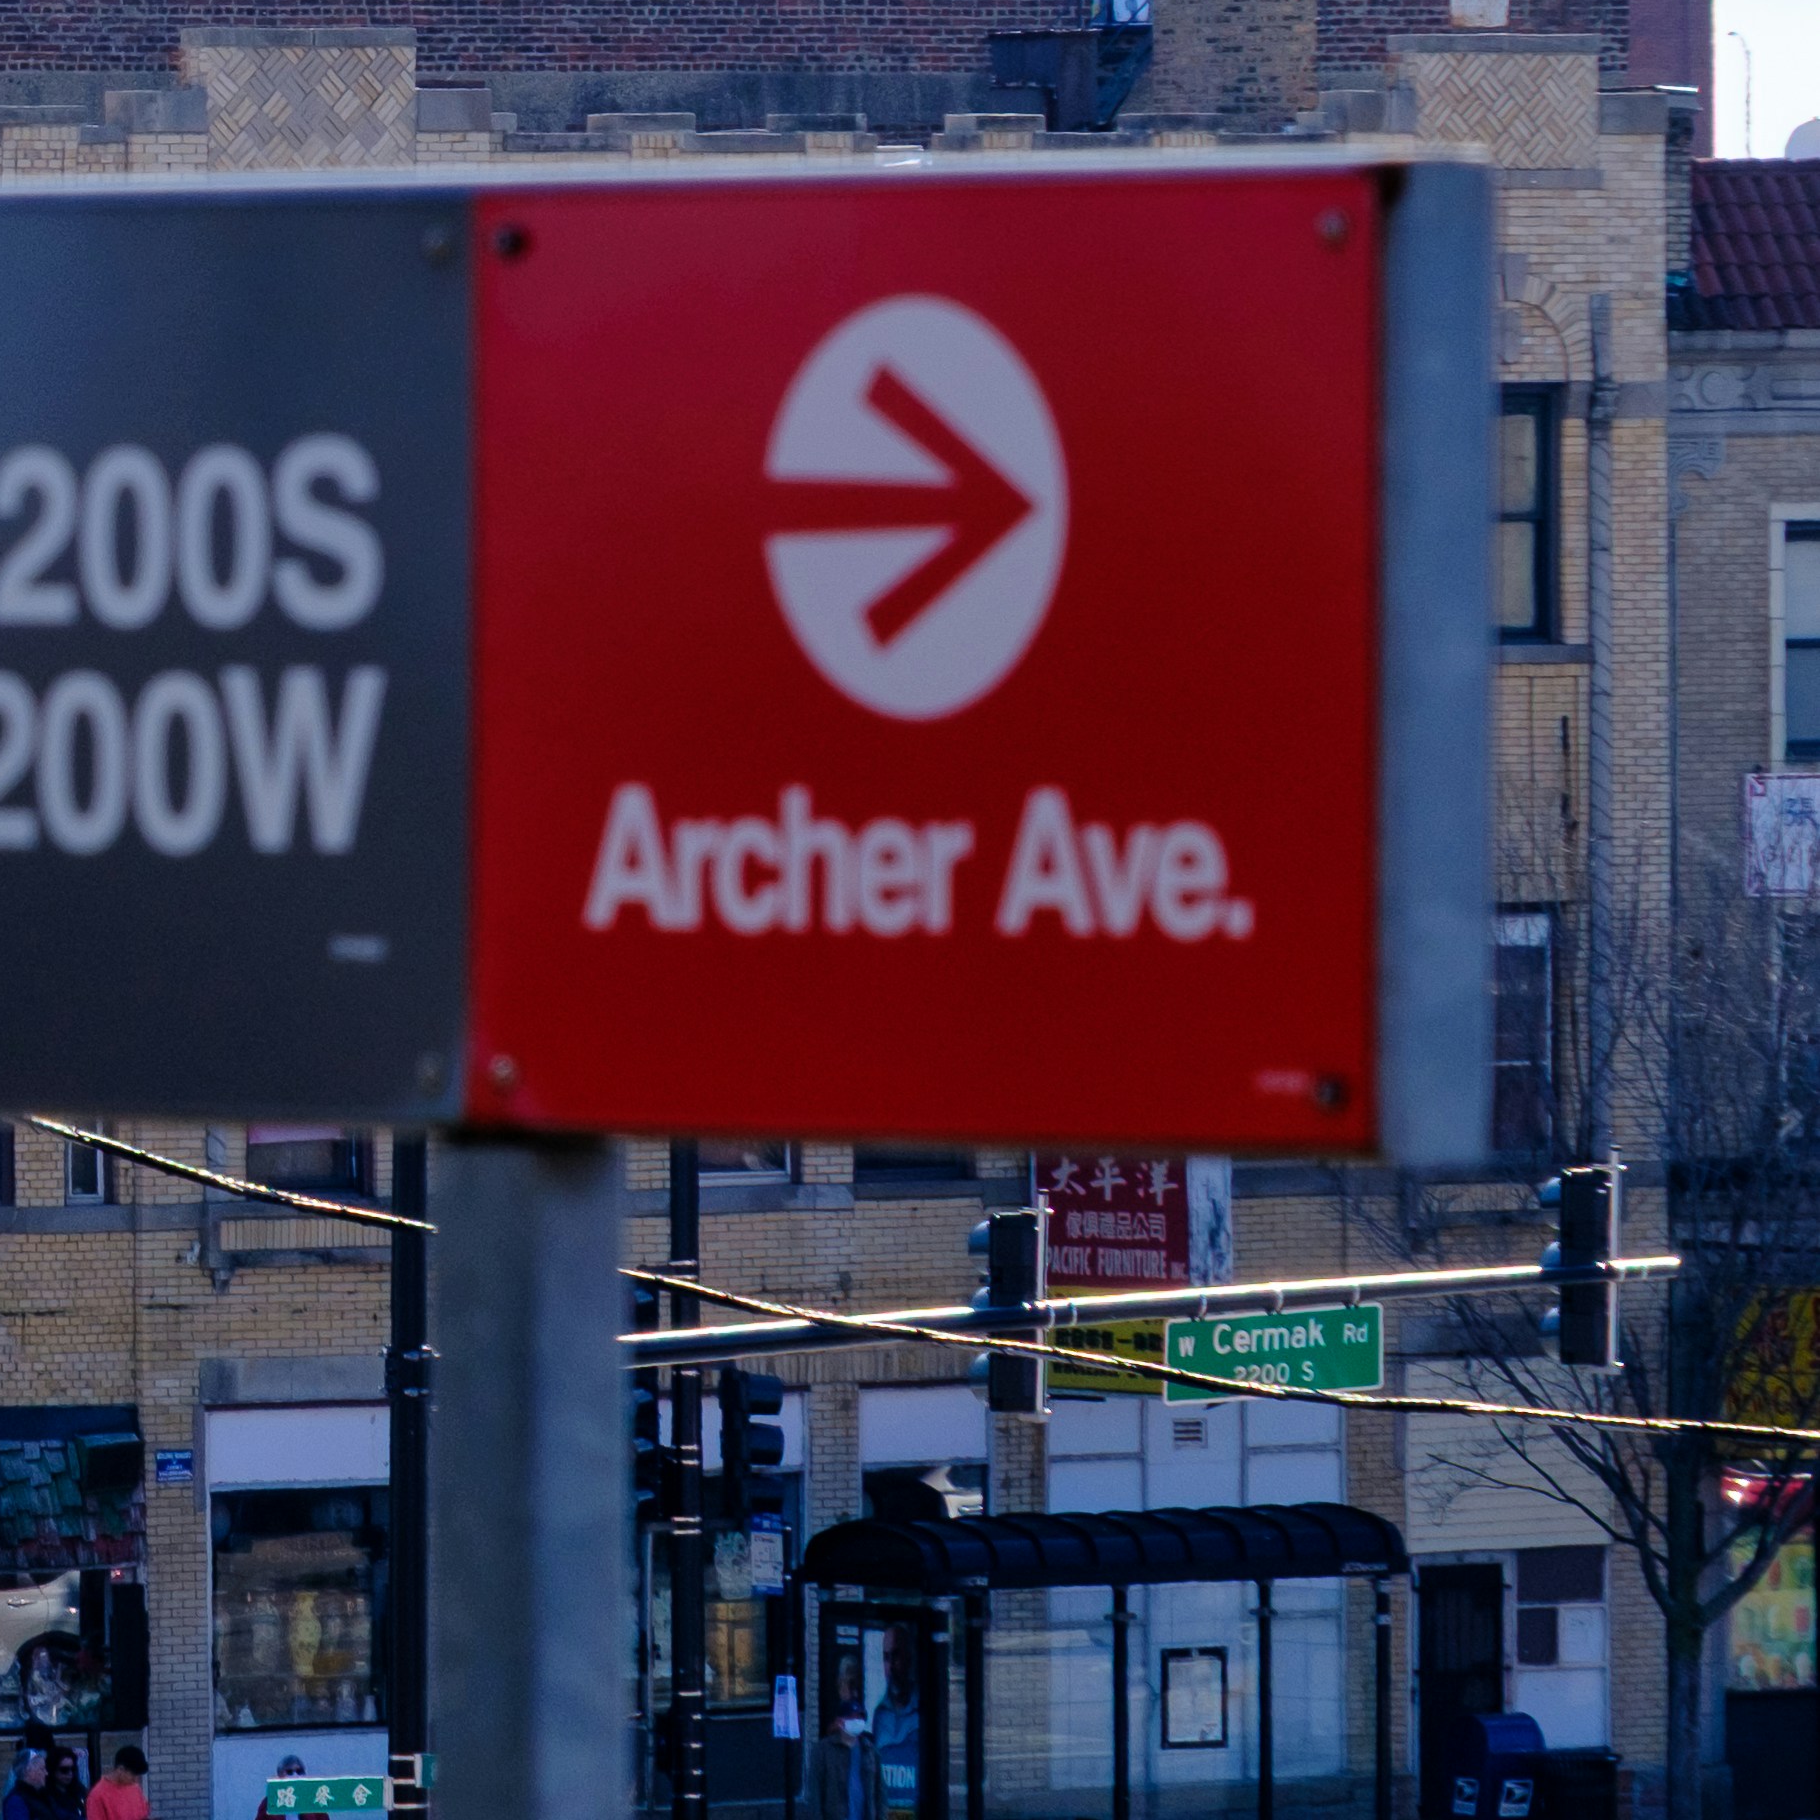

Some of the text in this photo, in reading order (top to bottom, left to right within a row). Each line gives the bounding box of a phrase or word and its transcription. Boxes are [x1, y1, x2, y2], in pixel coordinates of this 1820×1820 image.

[584, 783, 1254, 941] Archer Ave.
[1051, 1156, 1179, 1206] 太平洋
[1047, 1245, 1092, 1276] PACIFIC
[1098, 1246, 1167, 1279] FURNITURE
[1178, 1336, 1196, 1358] W
[1213, 1318, 1327, 1355] Cermak
[1342, 1323, 1369, 1346] Rd
[1233, 1361, 1315, 1385] 2200 S
